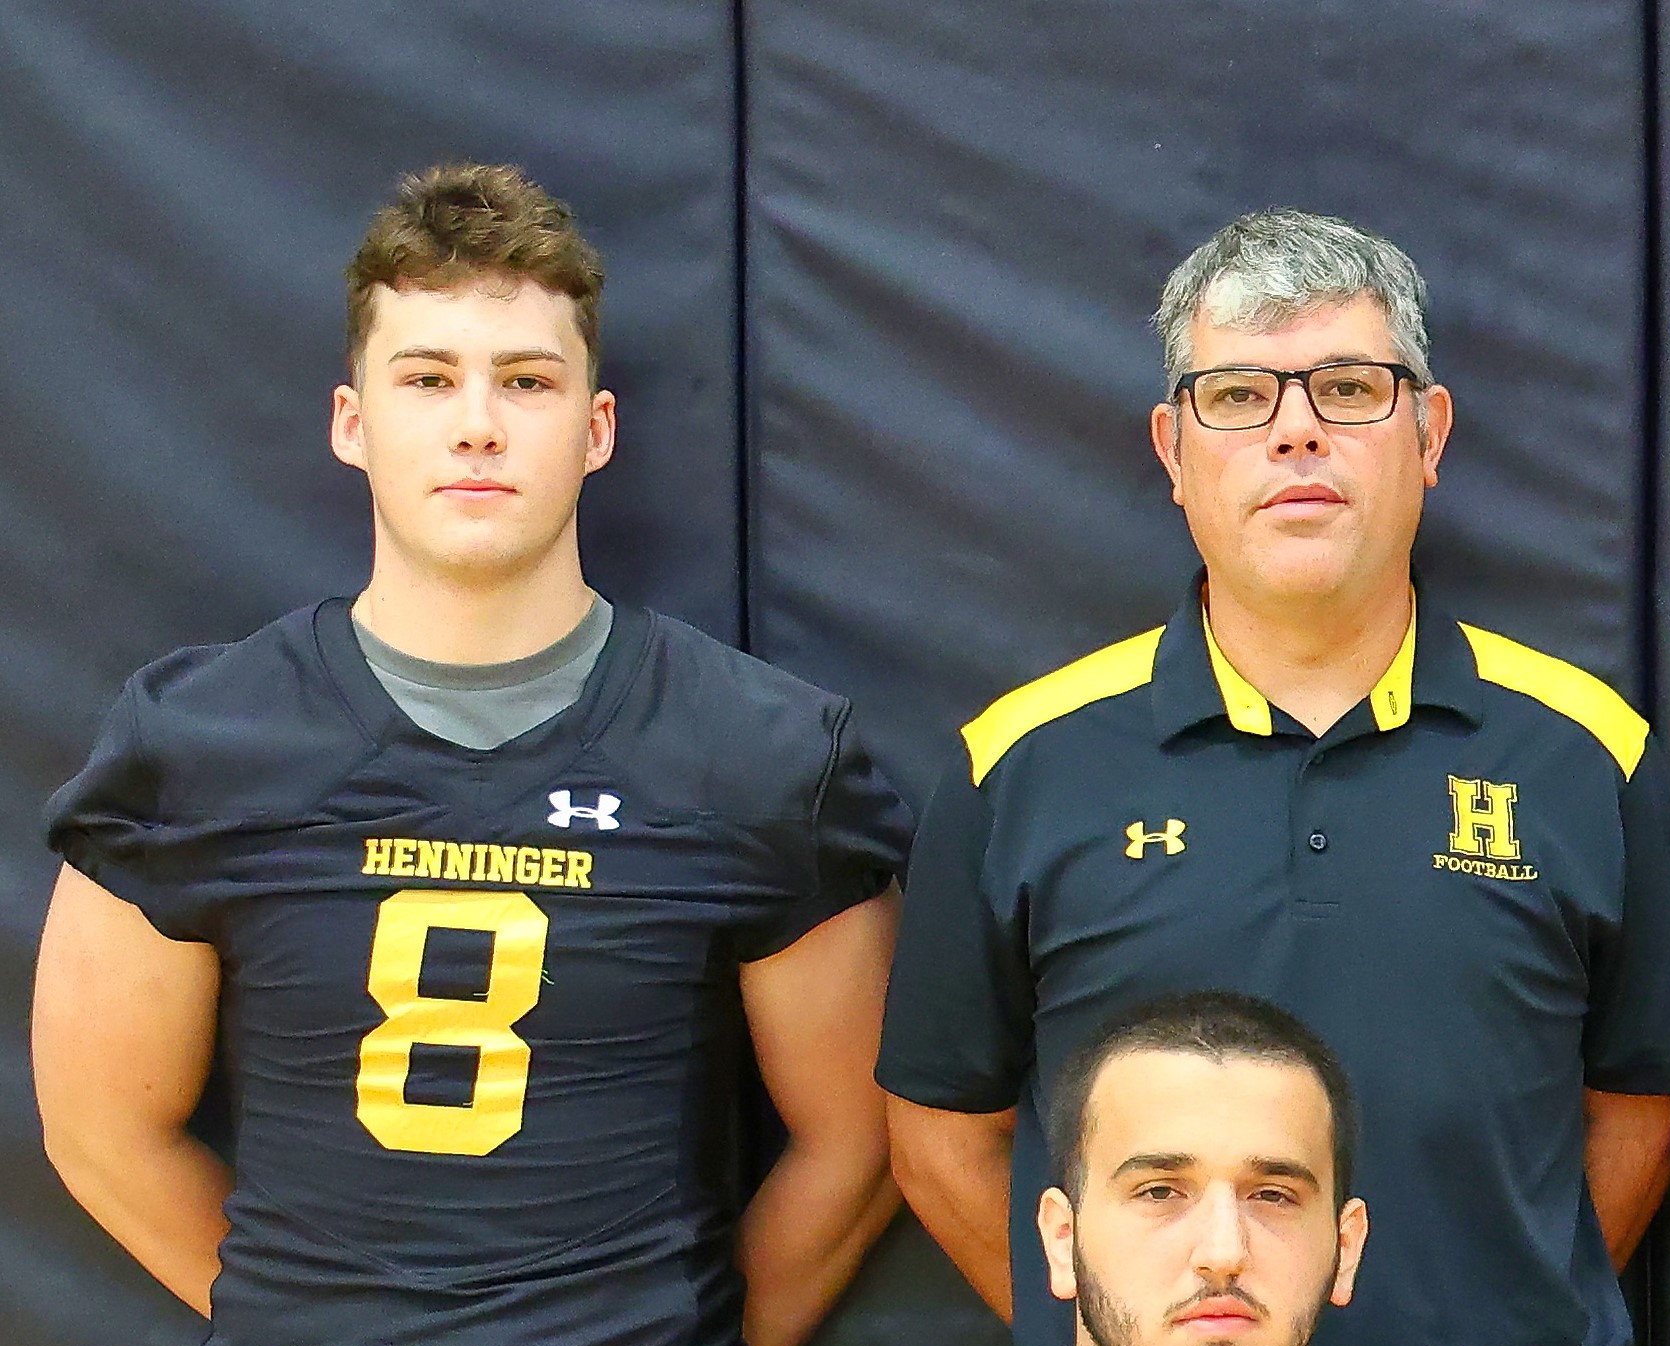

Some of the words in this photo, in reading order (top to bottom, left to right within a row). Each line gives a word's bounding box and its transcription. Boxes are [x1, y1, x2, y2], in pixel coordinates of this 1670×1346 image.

[1447, 774, 1521, 859] H
[361, 838, 593, 888] HENNINGER
[1432, 854, 1538, 880] FOOTBALL
[356, 889, 549, 1156] 8
